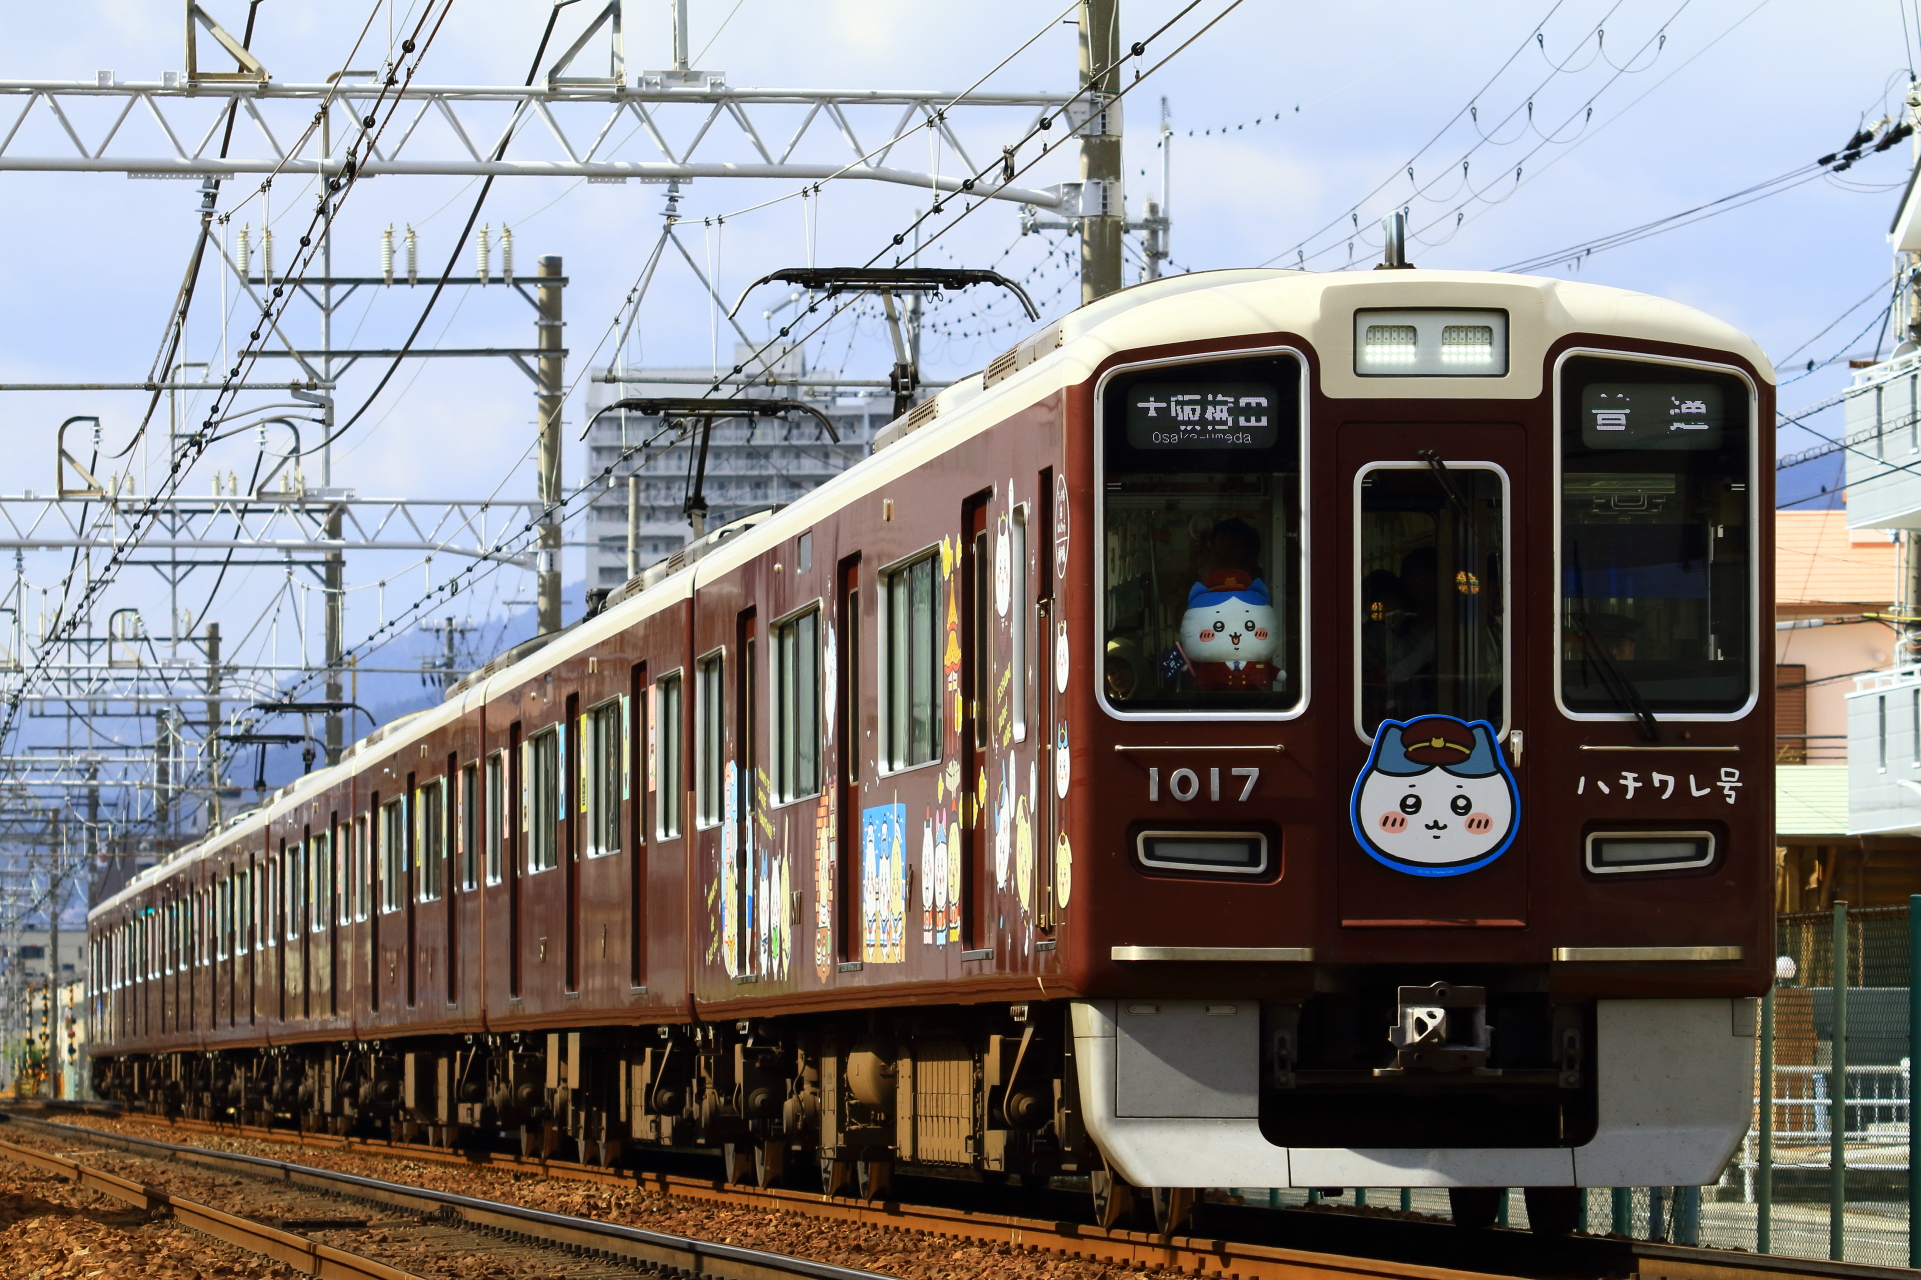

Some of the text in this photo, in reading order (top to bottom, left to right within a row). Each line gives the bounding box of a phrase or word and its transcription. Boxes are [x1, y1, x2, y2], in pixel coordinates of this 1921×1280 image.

[1149, 767, 1260, 802] 1017
[1577, 767, 1743, 804] ハチワレ号
